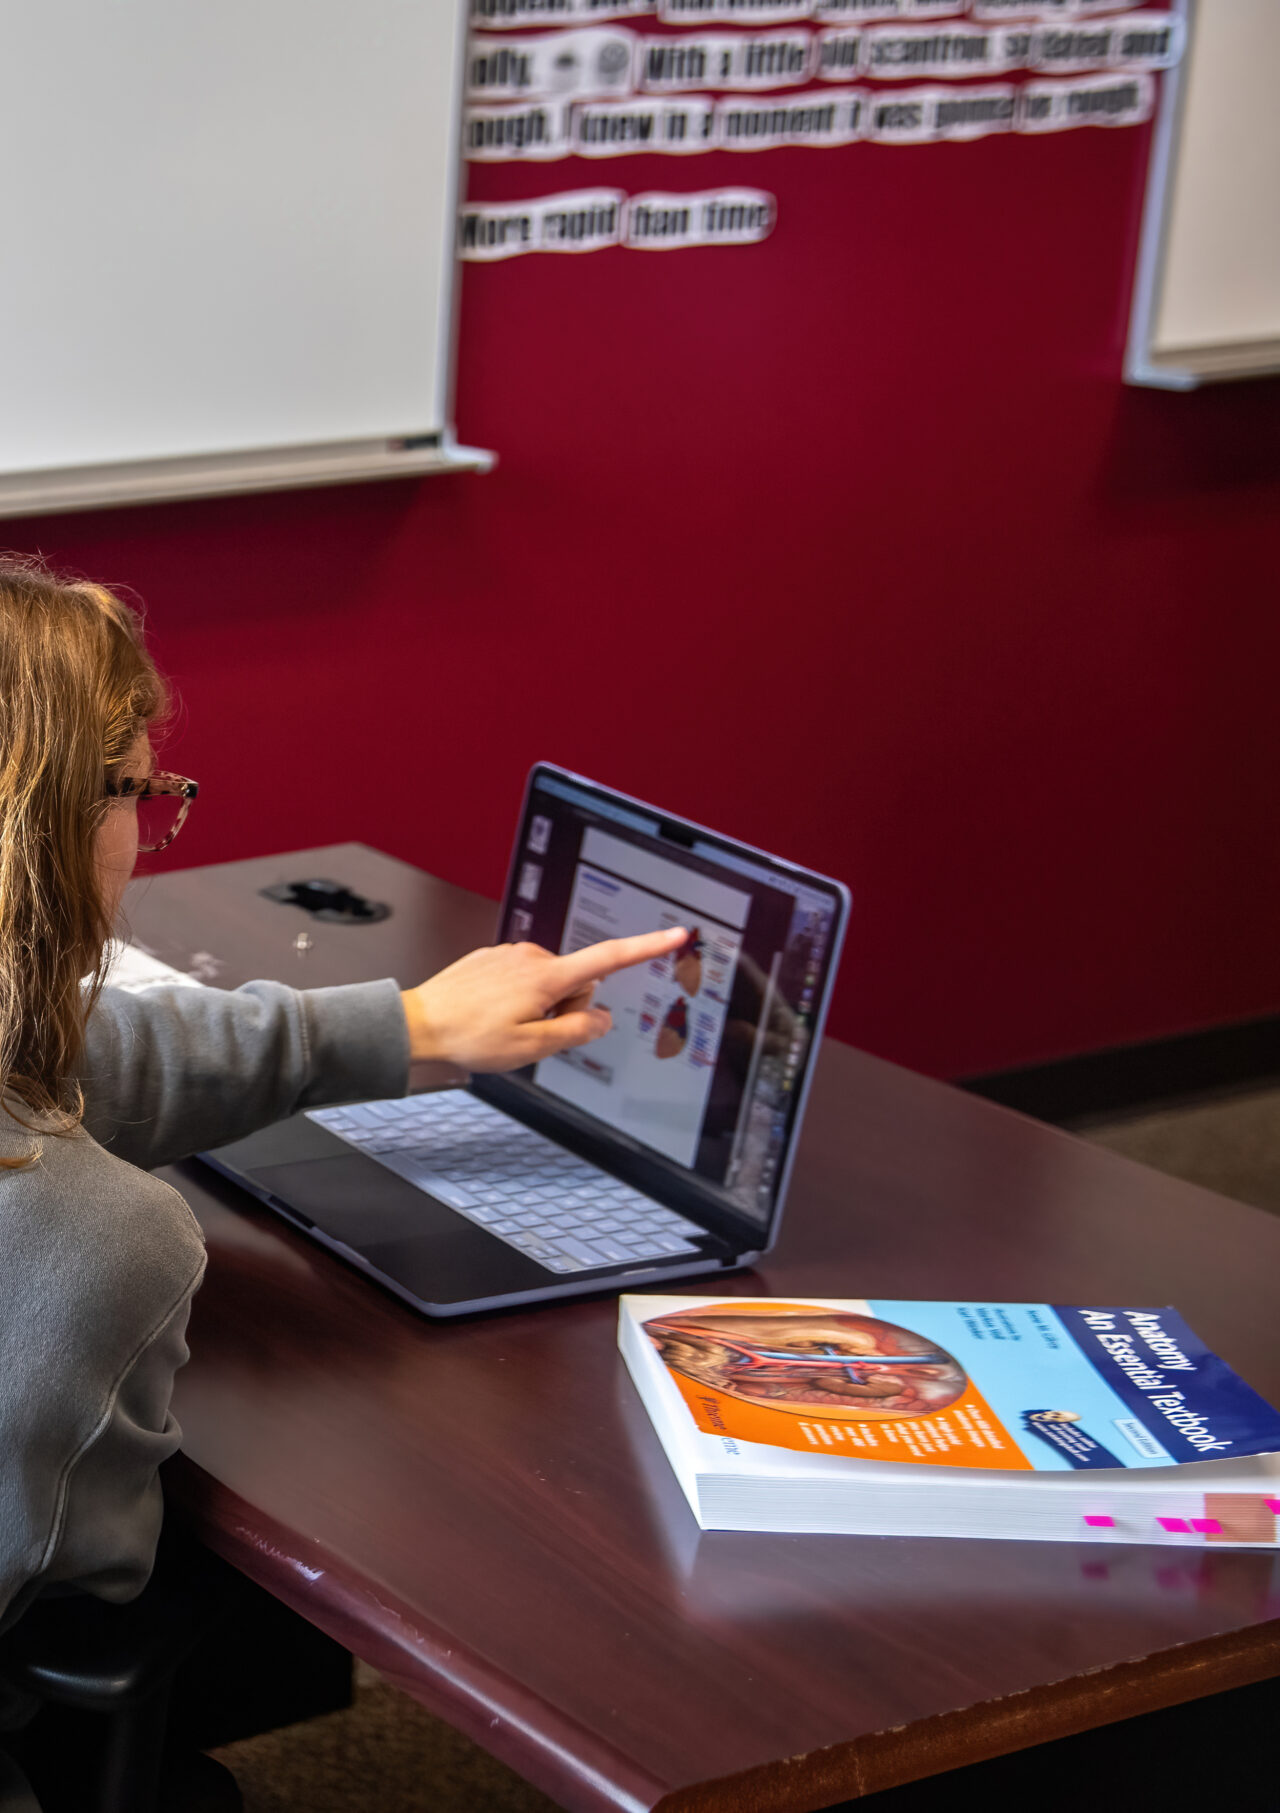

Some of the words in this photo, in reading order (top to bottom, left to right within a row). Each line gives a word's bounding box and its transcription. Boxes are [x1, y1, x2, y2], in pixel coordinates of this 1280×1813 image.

[646, 47, 705, 80] With
[744, 42, 804, 76] little
[461, 213, 529, 248] More
[544, 203, 615, 241] rapid
[634, 205, 688, 237] than
[1078, 1310, 1116, 1330] An
[1122, 1310, 1197, 1370] Anatomy
[1096, 1334, 1178, 1389] Essential
[1121, 1422, 1147, 1439] Second
[1147, 1391, 1233, 1451] Textbook
